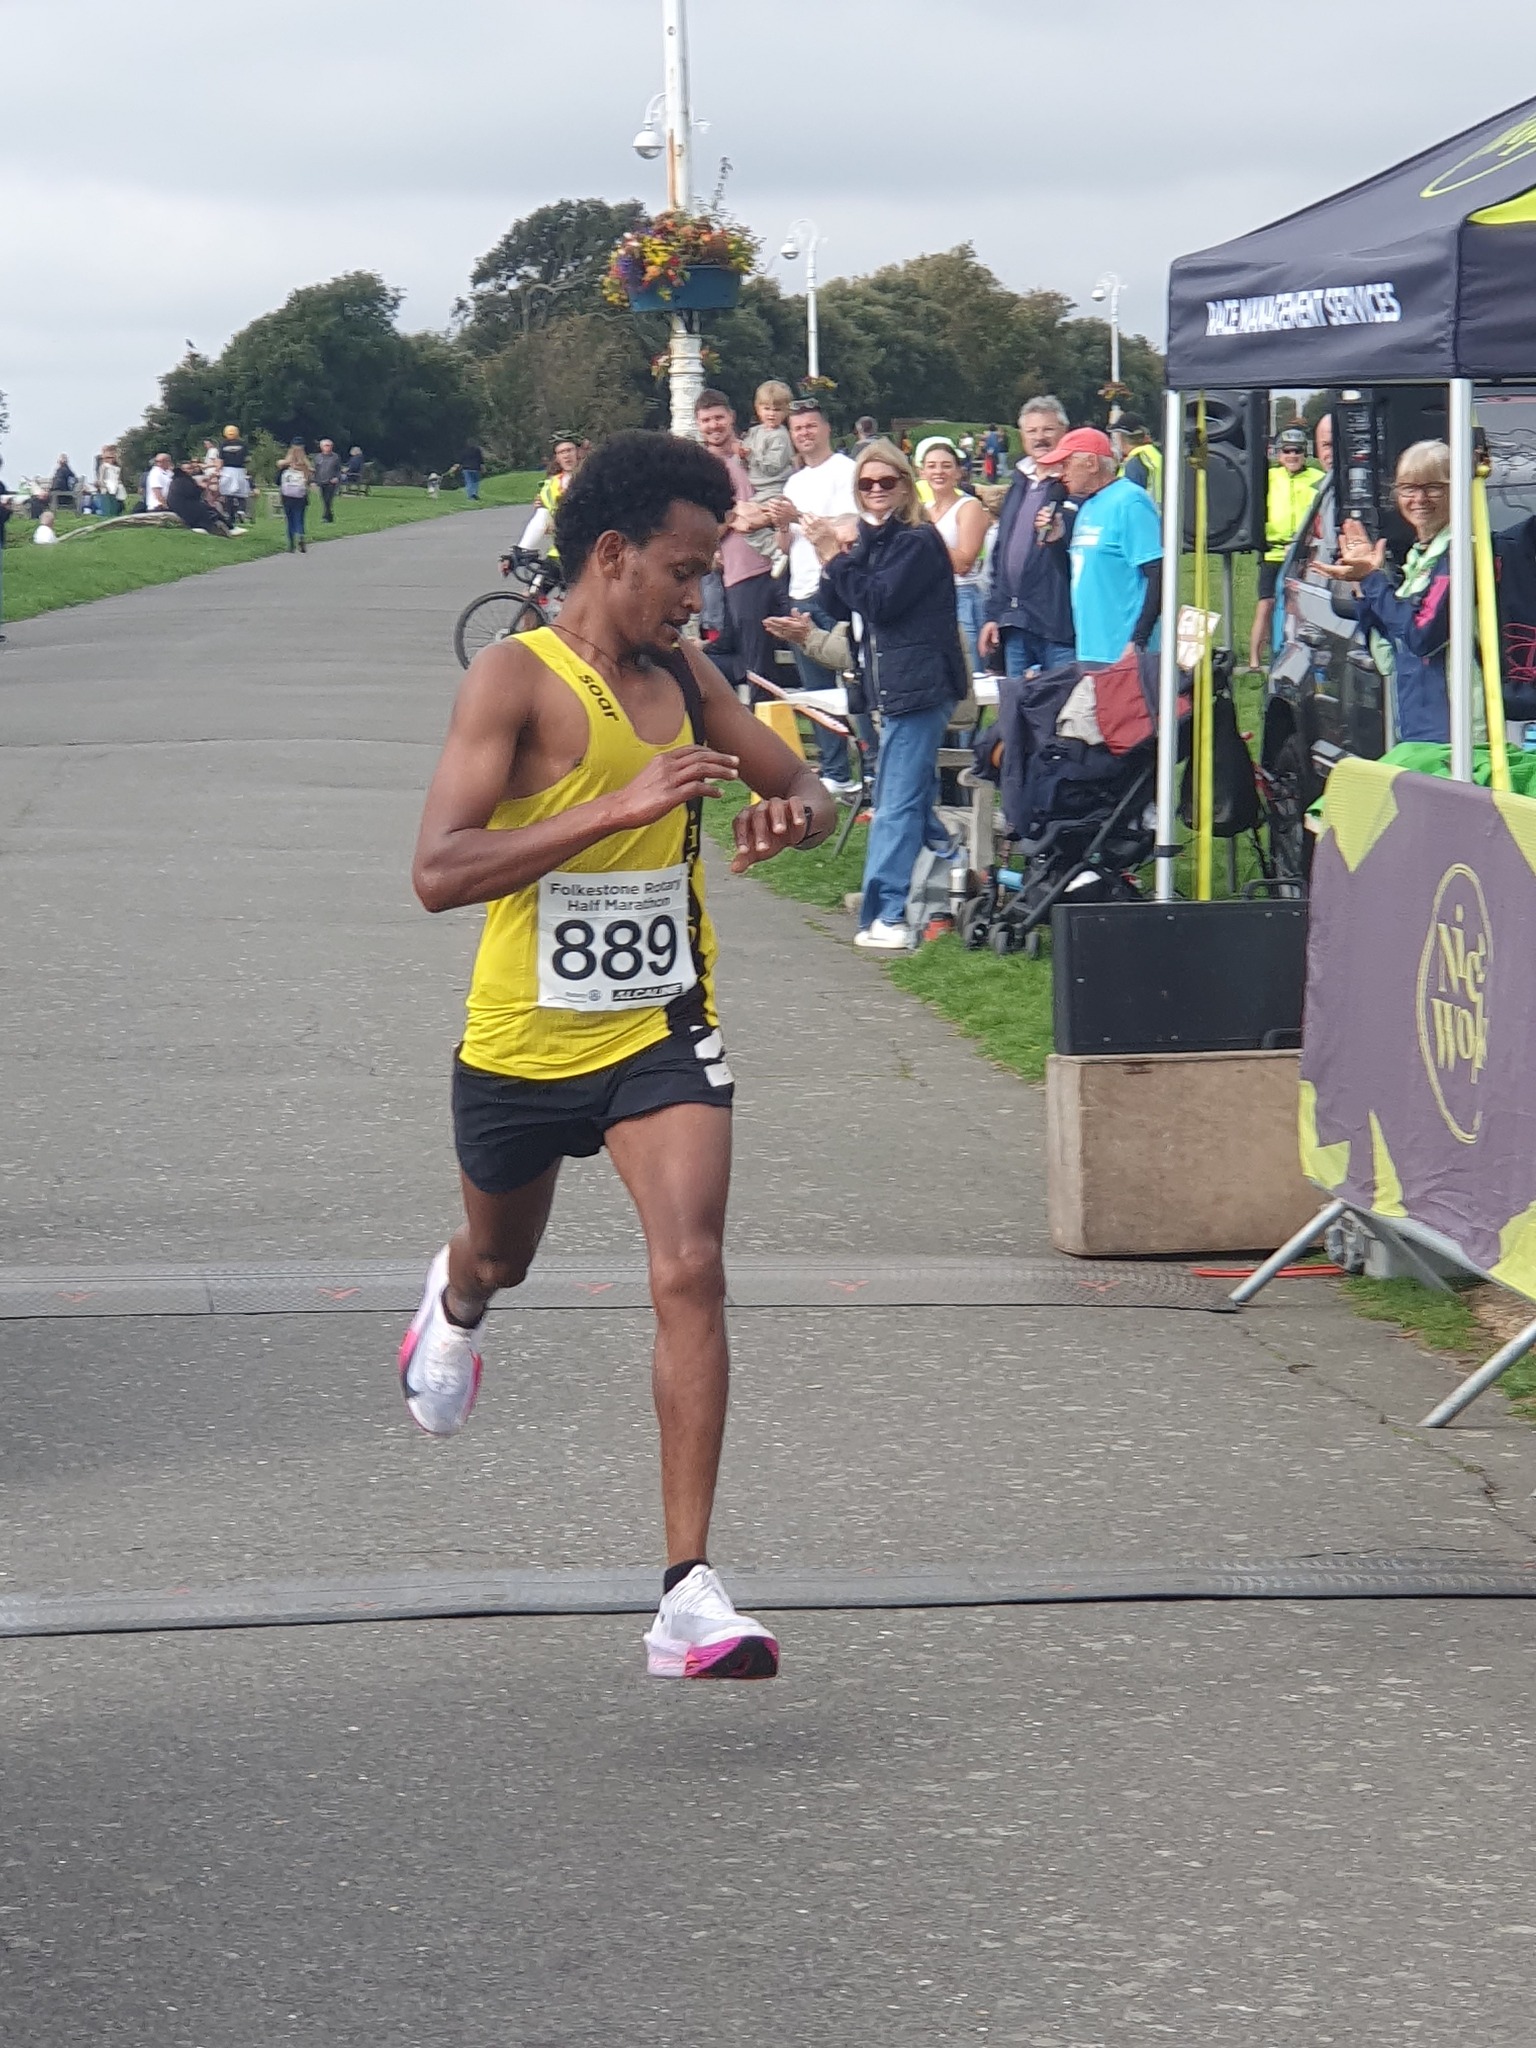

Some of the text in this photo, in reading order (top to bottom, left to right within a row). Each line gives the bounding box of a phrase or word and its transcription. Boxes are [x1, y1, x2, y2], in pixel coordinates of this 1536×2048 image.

[578, 674, 620, 722] soar
[550, 878, 682, 896] Folkestone Rotary
[567, 896, 671, 912] Half Marathon
[552, 914, 678, 981] 889
